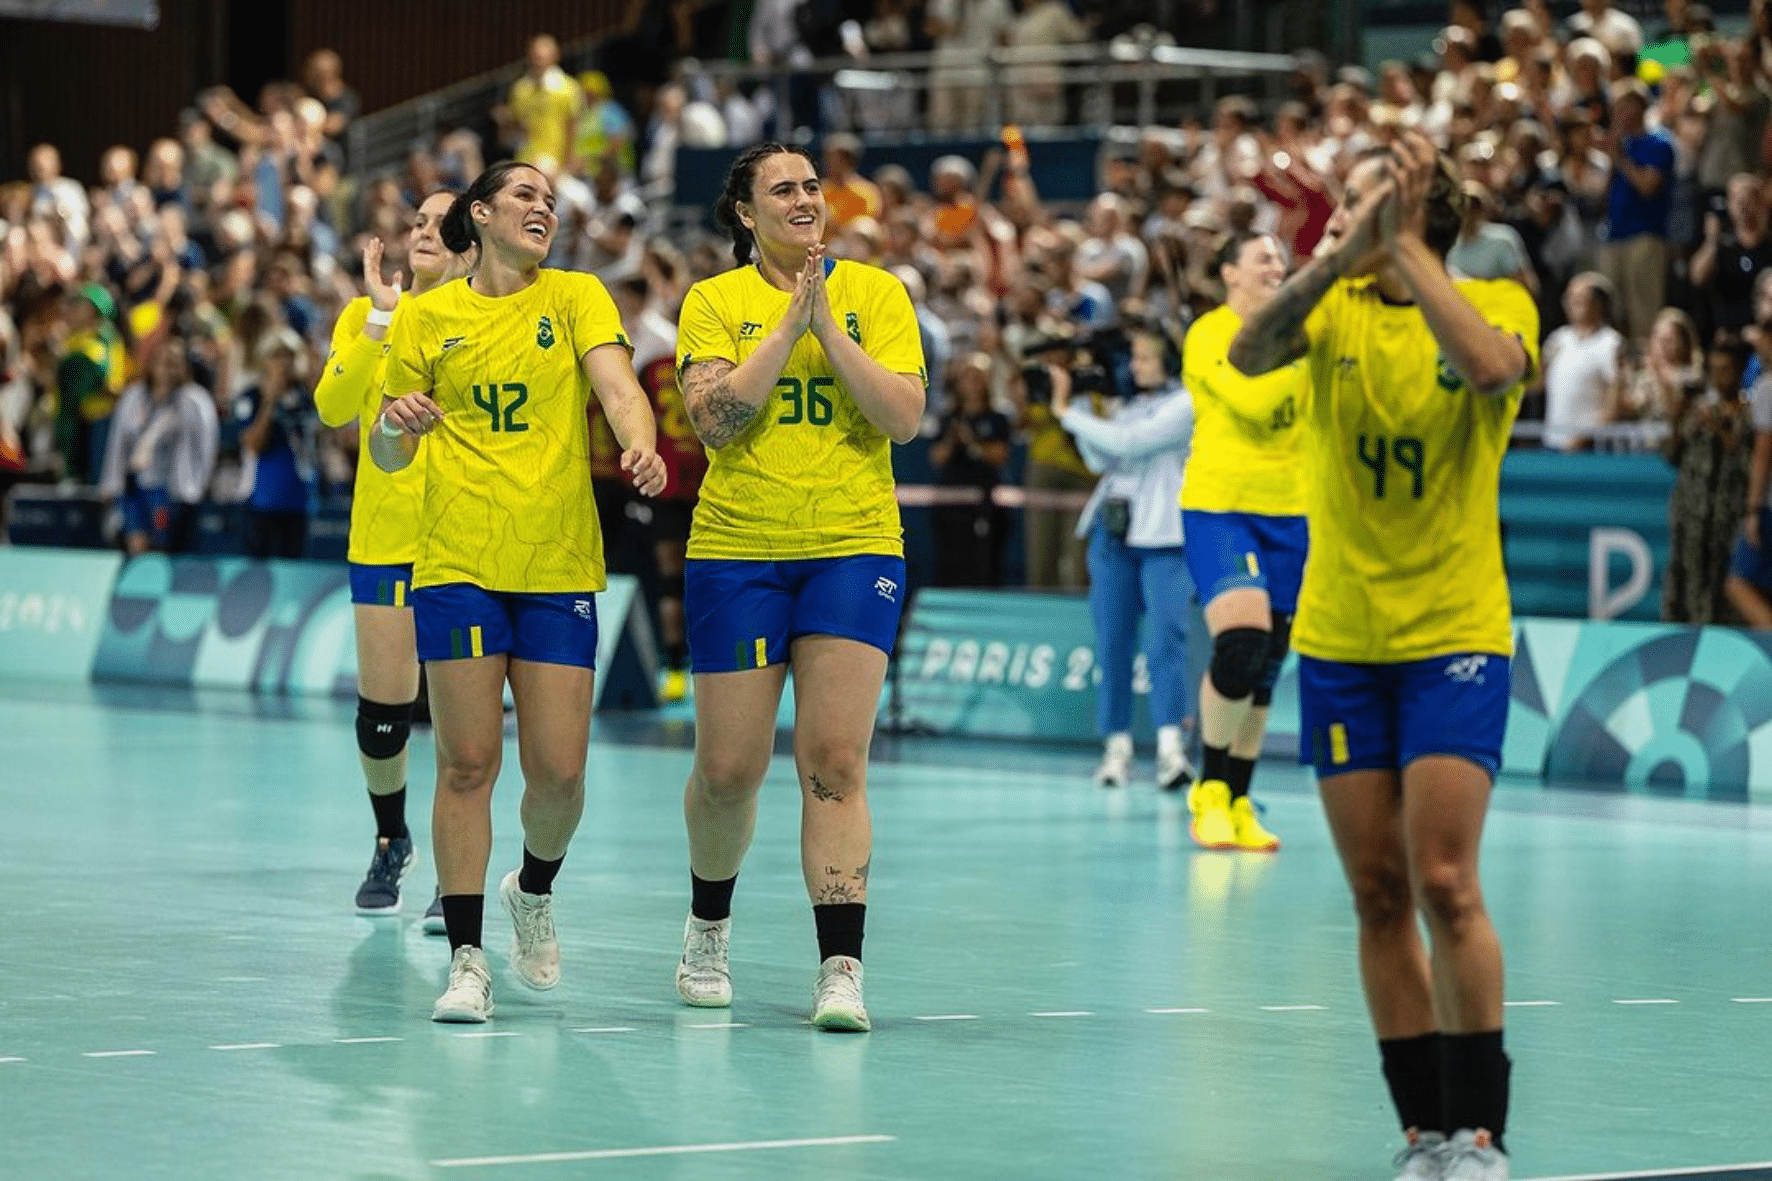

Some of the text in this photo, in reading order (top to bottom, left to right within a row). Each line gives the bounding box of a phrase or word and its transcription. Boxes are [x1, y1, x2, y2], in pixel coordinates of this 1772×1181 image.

[472, 383, 529, 432] 42
[777, 377, 834, 425] 36
[1358, 434, 1424, 498] 49
[921, 639, 1055, 688] PARIS
